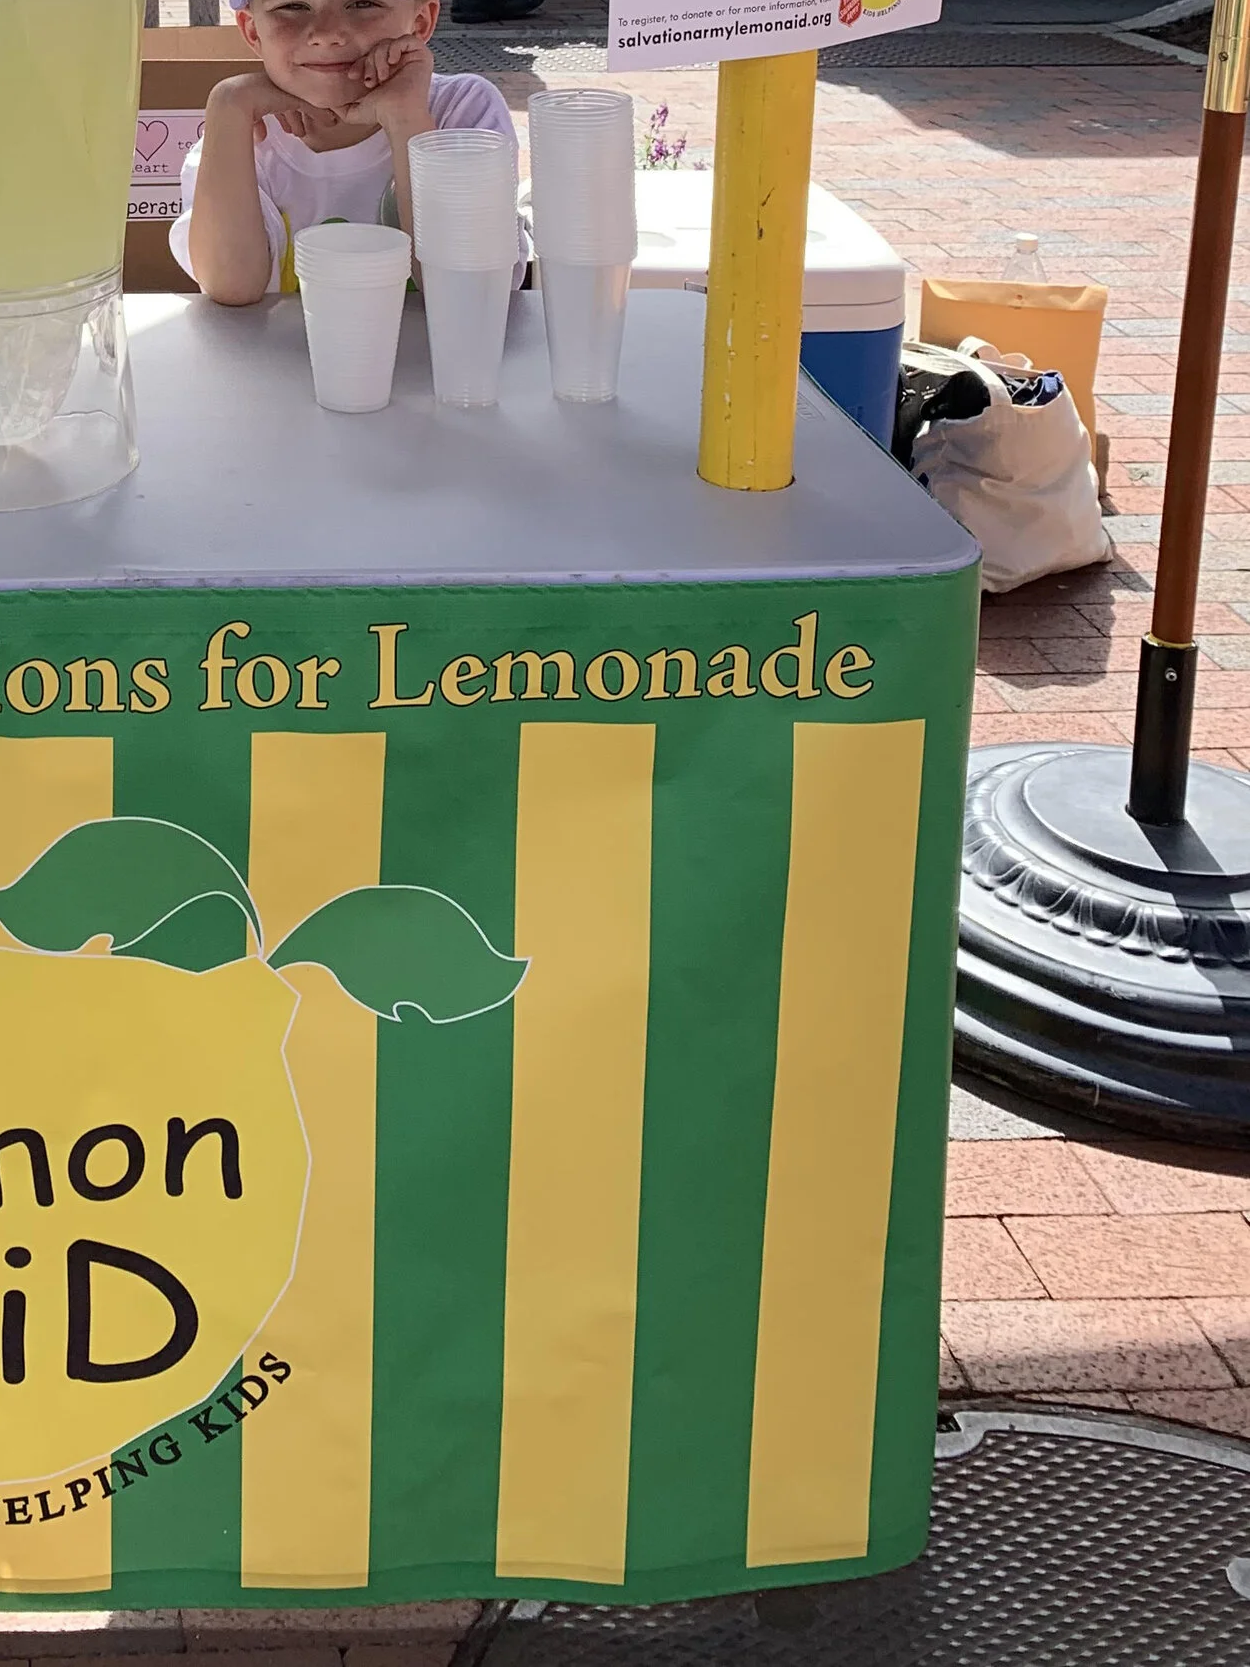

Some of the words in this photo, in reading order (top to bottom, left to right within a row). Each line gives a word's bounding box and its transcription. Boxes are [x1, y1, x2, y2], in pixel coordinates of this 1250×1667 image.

[618, 17, 628, 27] To
[631, 15, 667, 27] register,
[669, 13, 679, 22] to
[681, 10, 714, 22] donate
[716, 8, 725, 17] or
[728, 5, 741, 16] for
[744, 4, 766, 14] more
[618, 12, 832, 49] salvationarmylemonaid.org
[132, 164, 170, 173] eart
[198, 620, 341, 713] for
[368, 611, 874, 710] Lemonade
[188, 1350, 294, 1444] KIDS
